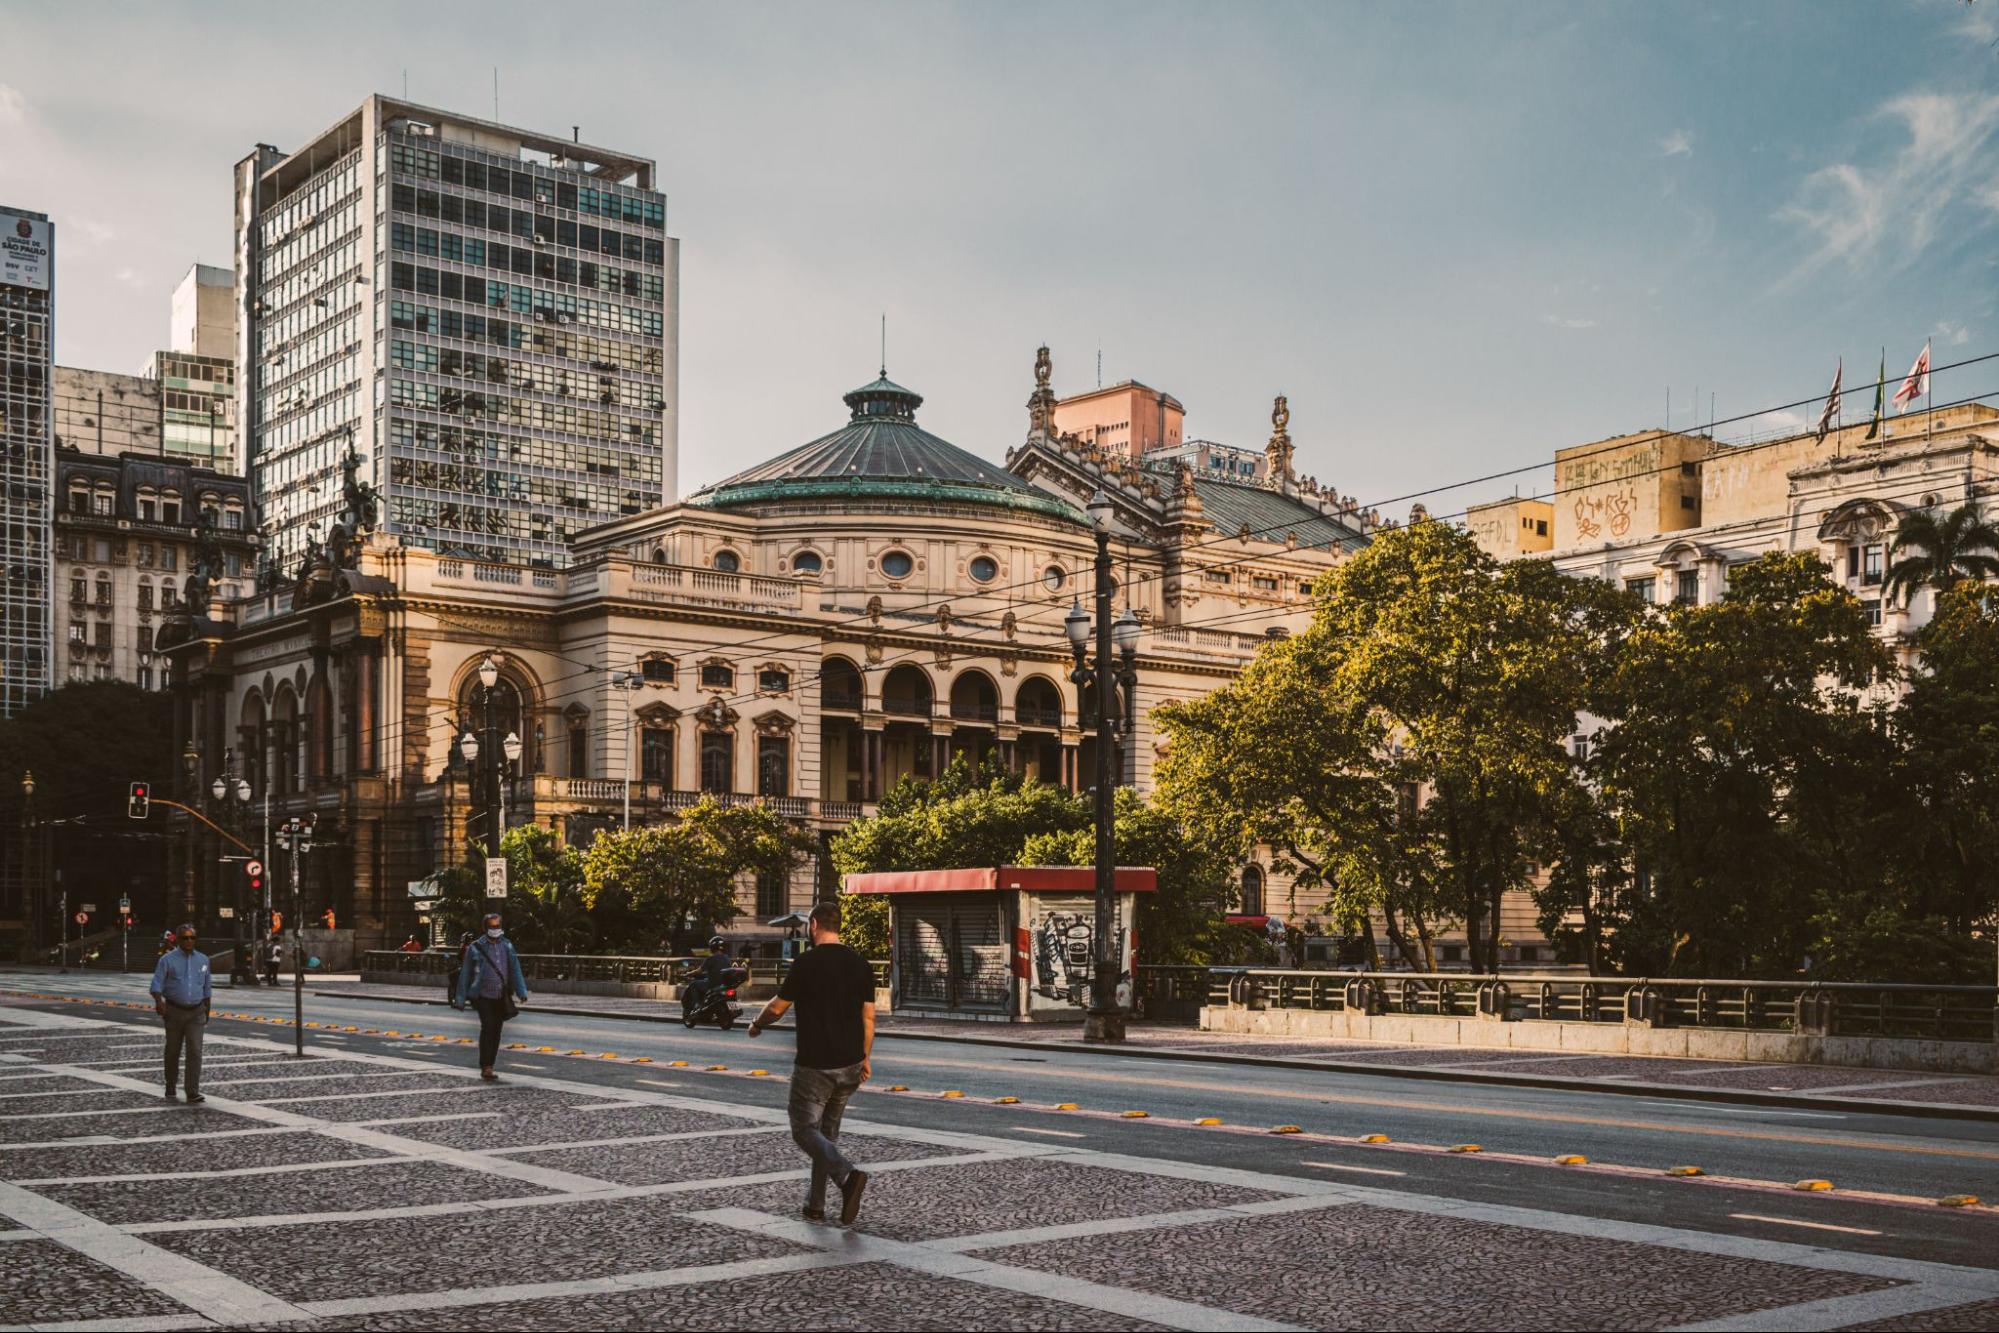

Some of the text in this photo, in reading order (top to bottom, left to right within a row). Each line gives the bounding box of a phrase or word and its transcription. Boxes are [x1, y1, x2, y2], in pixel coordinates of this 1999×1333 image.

[6, 236, 30, 245] CIDADE
[2, 241, 19, 251] SÃO
[20, 245, 46, 256] PAULO
